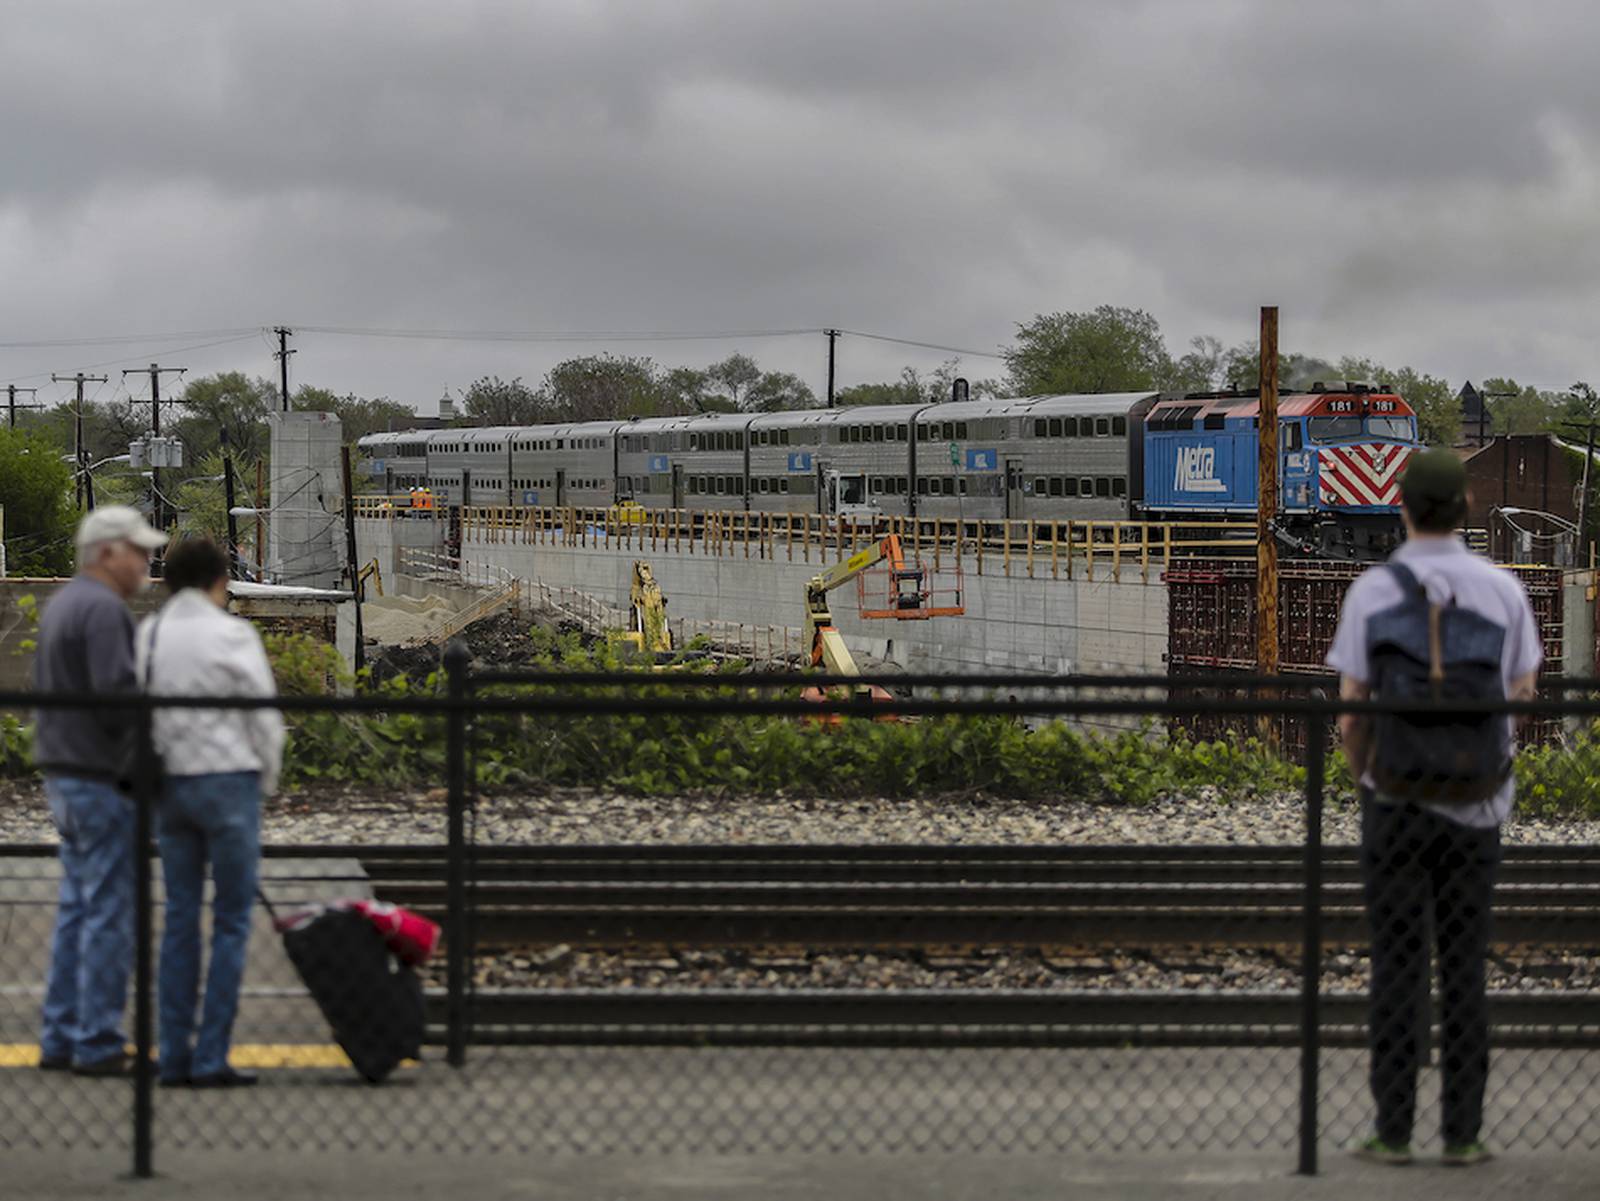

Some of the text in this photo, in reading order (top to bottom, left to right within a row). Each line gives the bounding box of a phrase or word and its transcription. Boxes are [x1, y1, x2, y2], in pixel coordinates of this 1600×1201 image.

[1330, 401, 1352, 412] 181
[1375, 401, 1394, 412] 181
[1174, 442, 1217, 492] Metra
